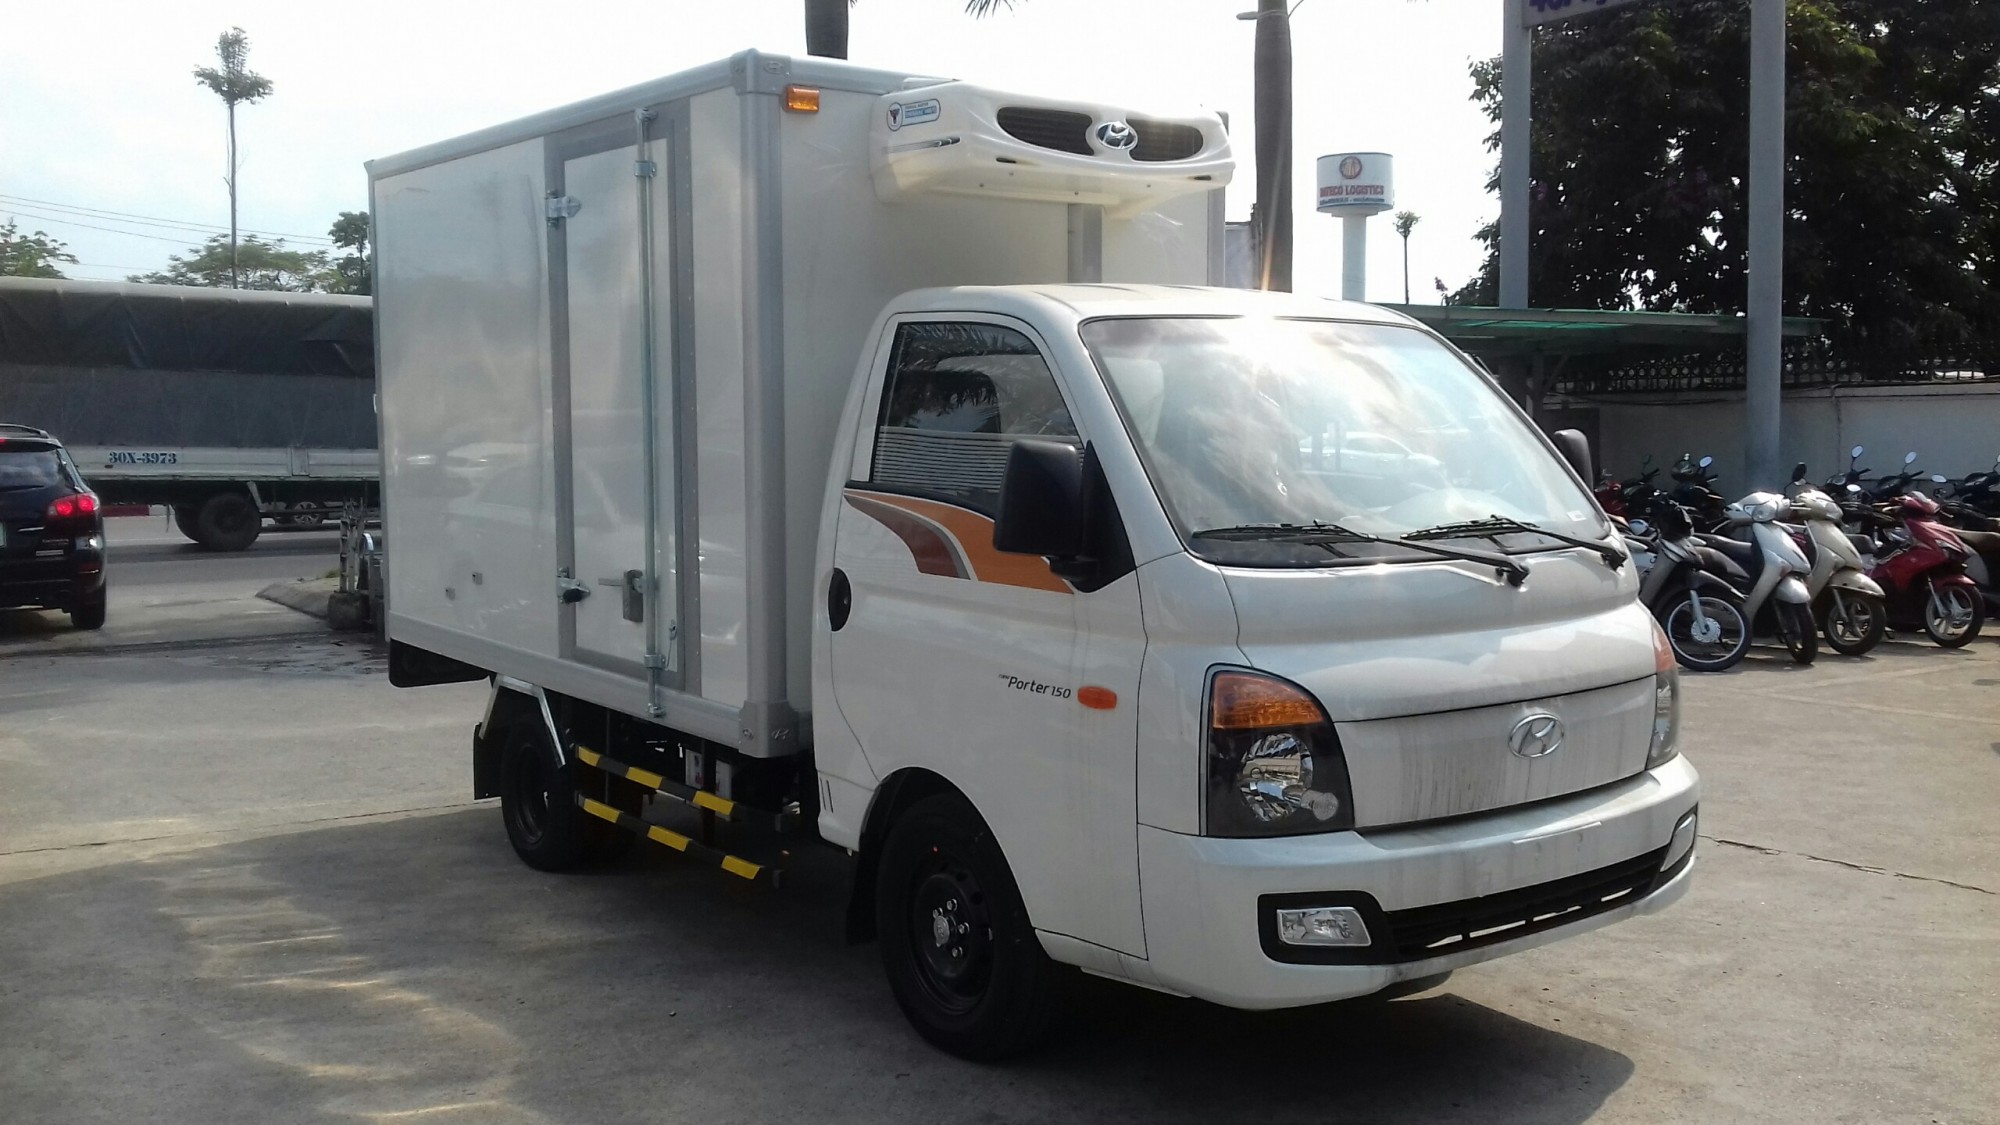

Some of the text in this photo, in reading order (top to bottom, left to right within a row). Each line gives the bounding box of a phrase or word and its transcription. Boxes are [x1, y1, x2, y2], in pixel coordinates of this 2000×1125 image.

[1345, 185, 1384, 196] LOGISTICS
[109, 451, 177, 464] 30X-3973
[1007, 676, 1050, 694] Porter
[1051, 686, 1071, 699] 150
